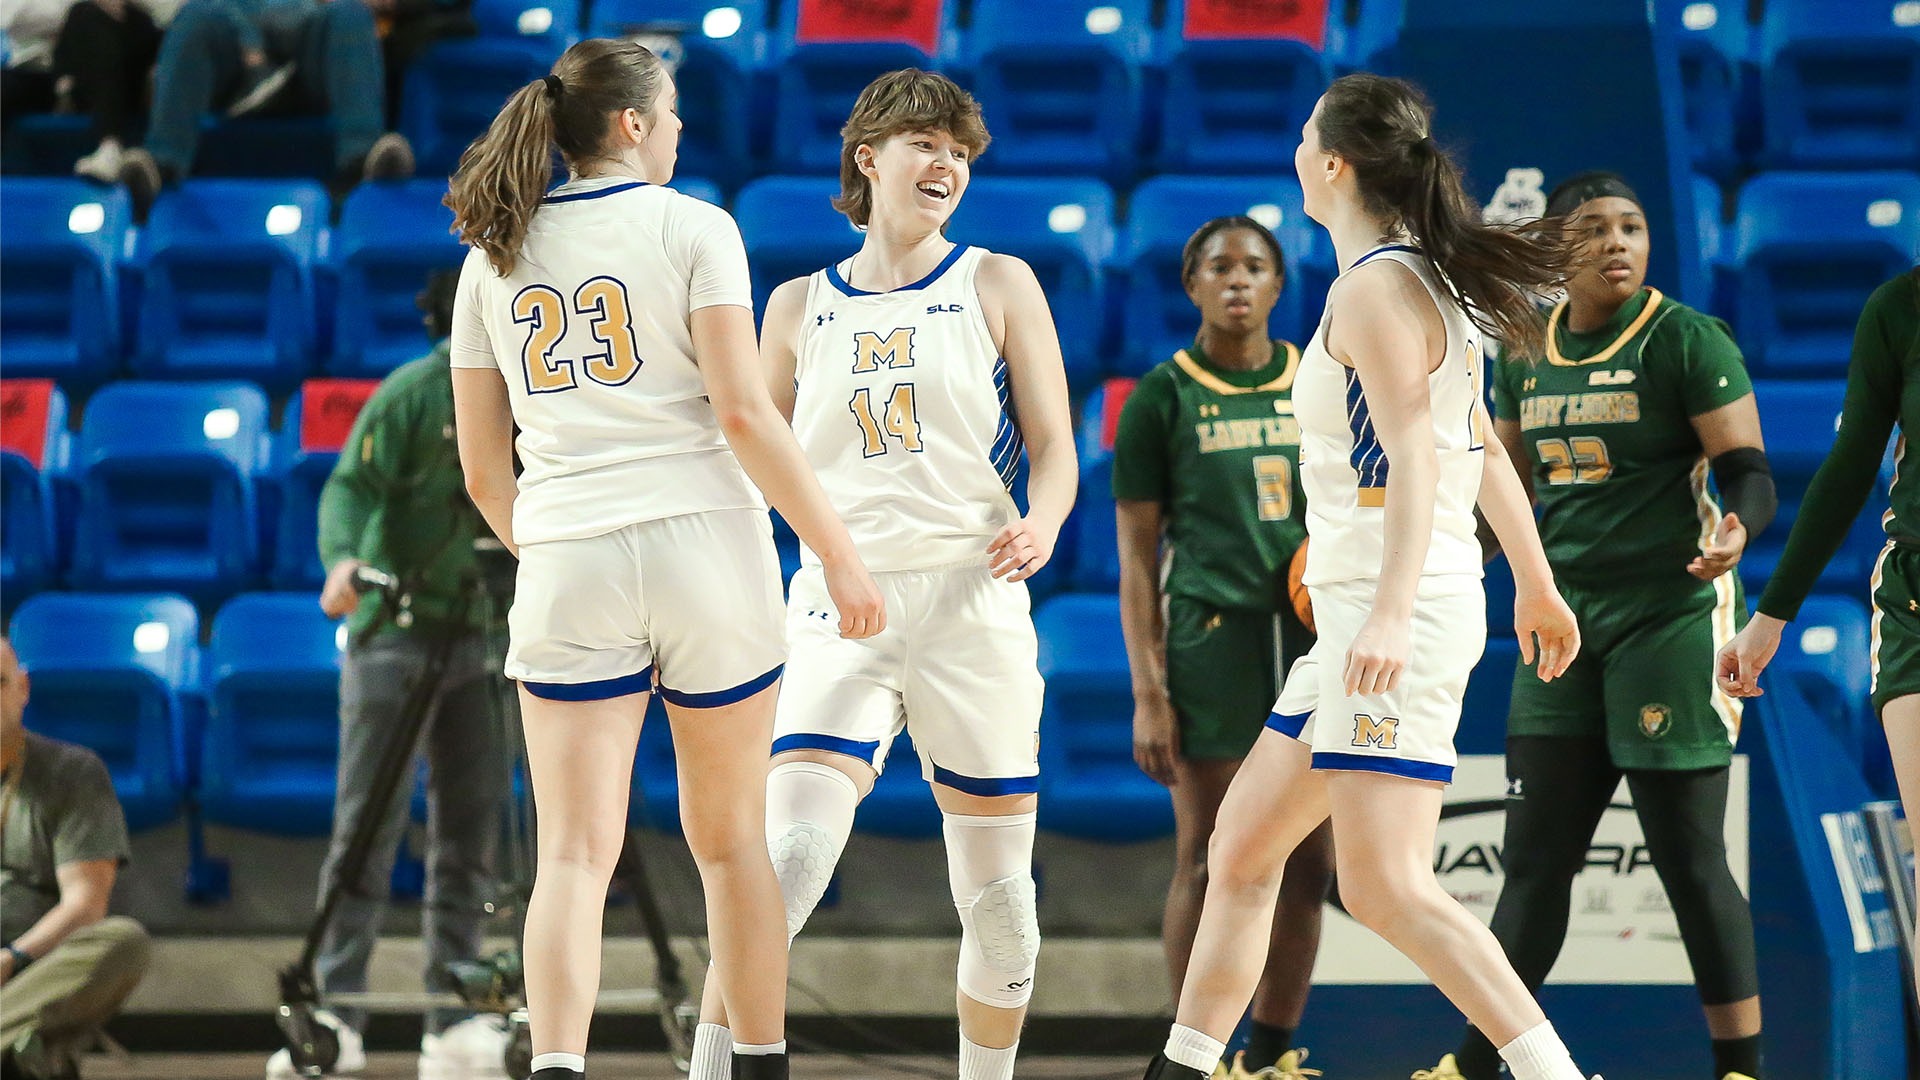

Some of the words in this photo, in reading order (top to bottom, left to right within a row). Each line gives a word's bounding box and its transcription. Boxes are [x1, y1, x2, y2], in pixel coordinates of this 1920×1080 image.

[511, 275, 644, 395] 23
[852, 326, 916, 375] M
[849, 382, 924, 459] 14
[1564, 391, 1641, 426] LIONS
[1195, 417, 1264, 454] LADY
[1351, 713, 1400, 750] M
